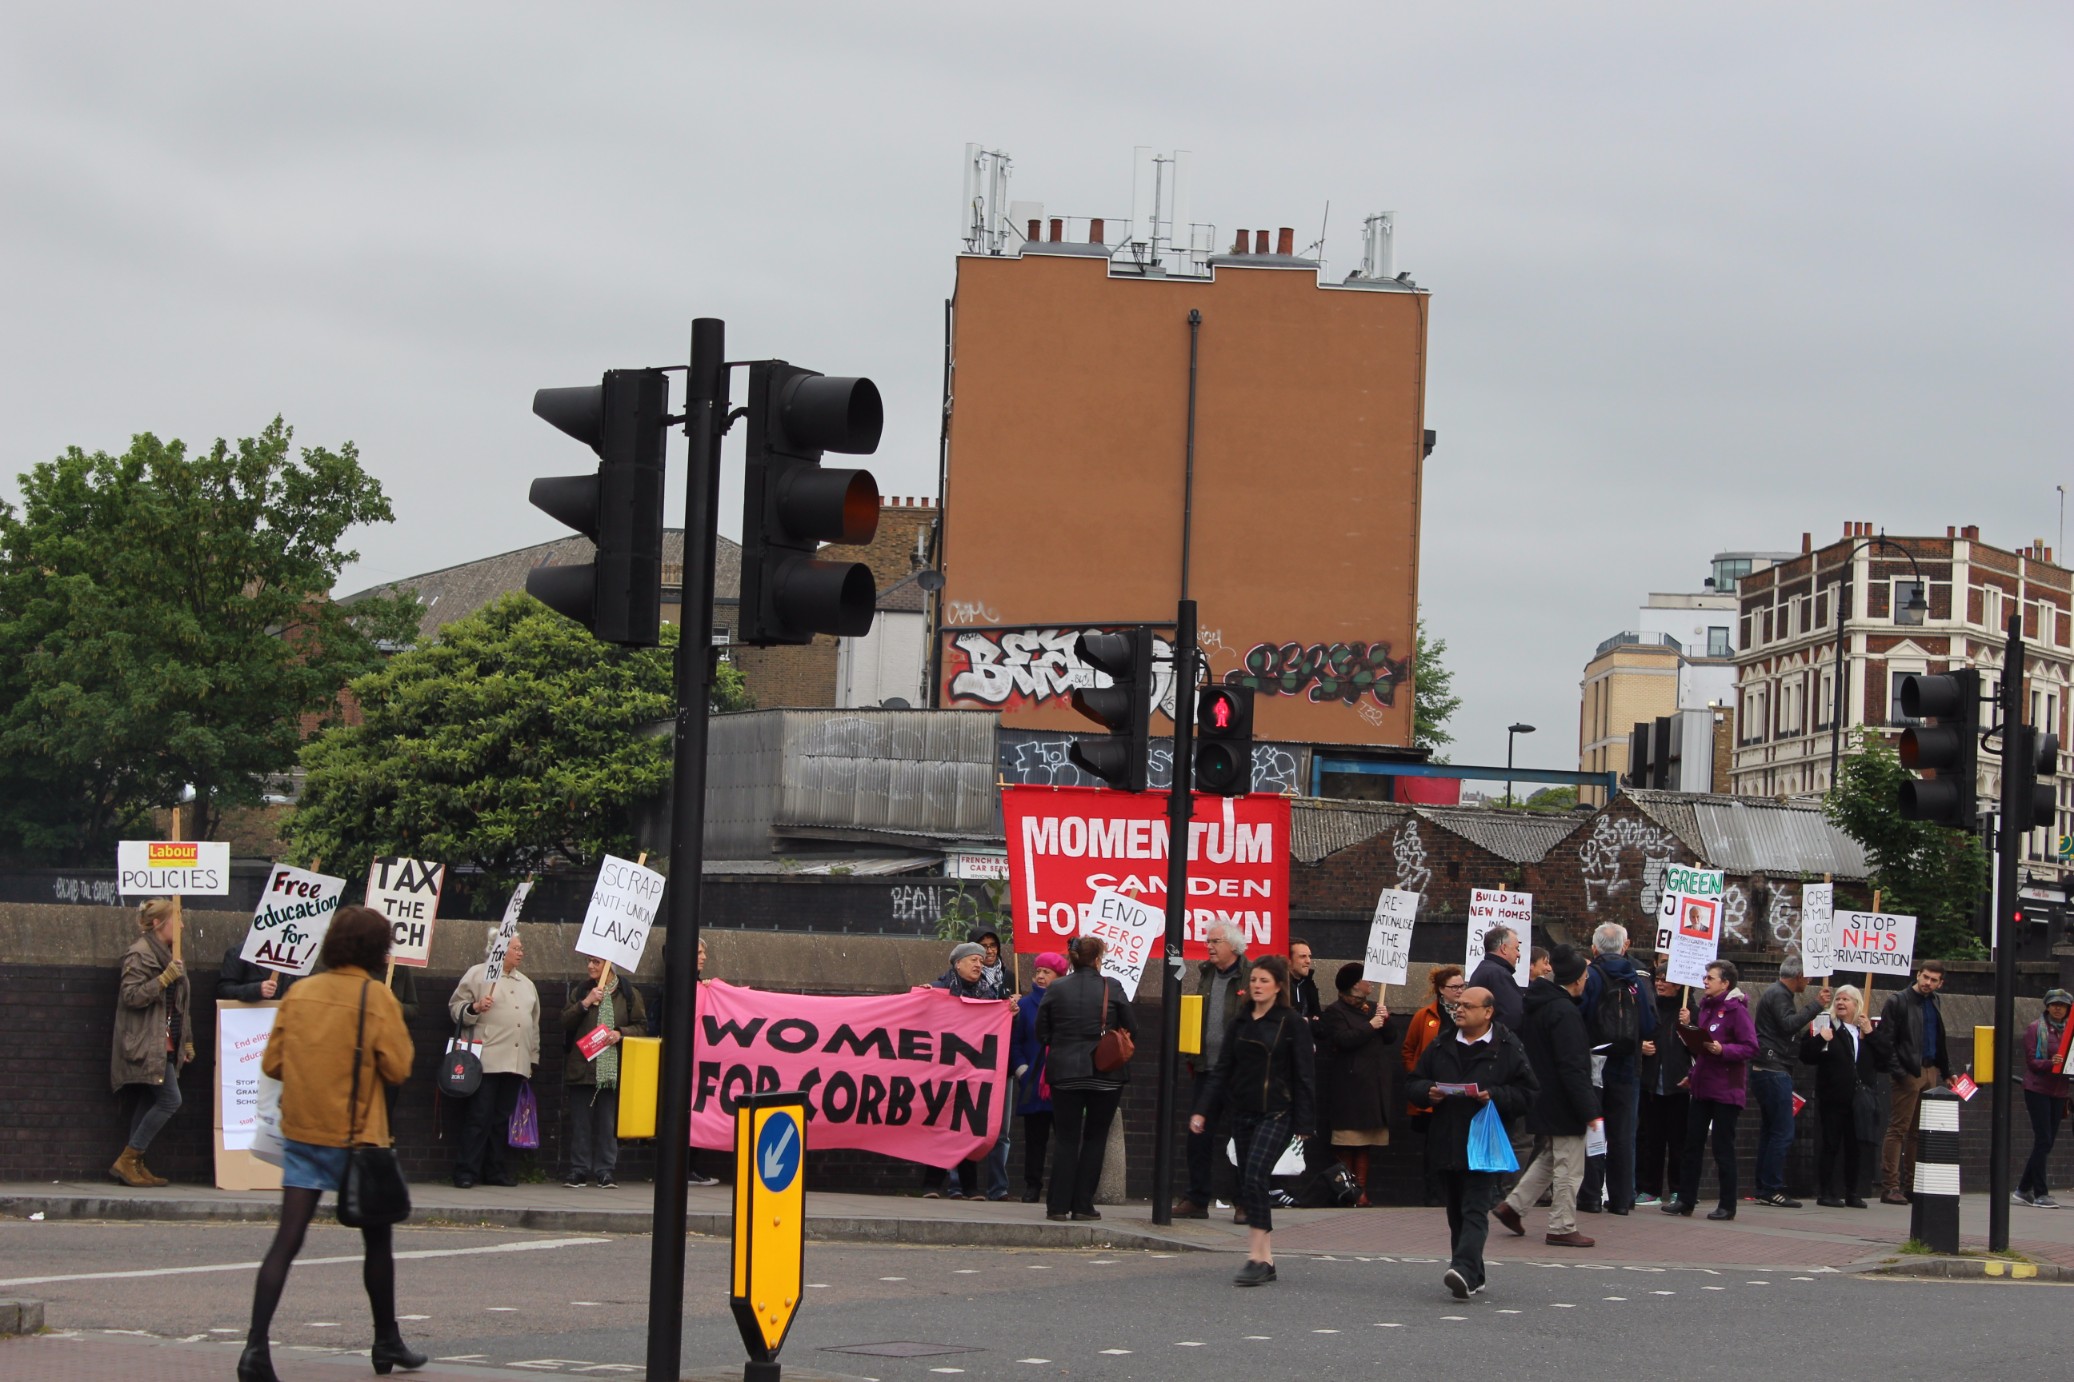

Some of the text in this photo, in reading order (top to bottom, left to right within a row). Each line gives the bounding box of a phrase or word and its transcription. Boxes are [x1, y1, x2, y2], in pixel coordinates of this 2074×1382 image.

[150, 845, 197, 857] Labour
[961, 856, 992, 864] FRENCH
[122, 869, 219, 889] POLICIES
[272, 872, 321, 899] Free
[375, 857, 443, 896] TAX
[603, 863, 662, 900] SCRAP
[1667, 868, 1724, 894] GREEN
[1383, 895, 1403, 911] RE-
[1476, 892, 1507, 902] BUILD
[1807, 890, 1831, 906] CRE
[253, 895, 339, 931] education
[383, 898, 425, 919] THE
[591, 891, 655, 926] ANTI-UNION
[1102, 899, 1147, 926] END
[1470, 906, 1531, 921] NEW HOMES
[1803, 908, 1810, 920] A
[1372, 914, 1414, 930] NATIONALISE
[1851, 914, 1896, 931] STOP
[281, 923, 309, 945] for
[392, 921, 426, 947] CH
[592, 916, 643, 951] LAWS
[1092, 921, 1144, 949] ZERO
[1381, 931, 1399, 948] THE
[1843, 928, 1897, 951] NHS
[255, 939, 317, 965] ALL!
[1105, 942, 1139, 964] URS
[1365, 946, 1408, 970] RAILWAYS
[1833, 949, 1910, 967] PRIVATISATION
[1102, 958, 1141, 982] tracts
[234, 1032, 272, 1050] End elitis
[701, 1014, 998, 1070] WOMEN
[239, 1049, 265, 1063] educa
[799, 1067, 992, 1137] CORBYN
[434, 1354, 648, 1372] LEF
